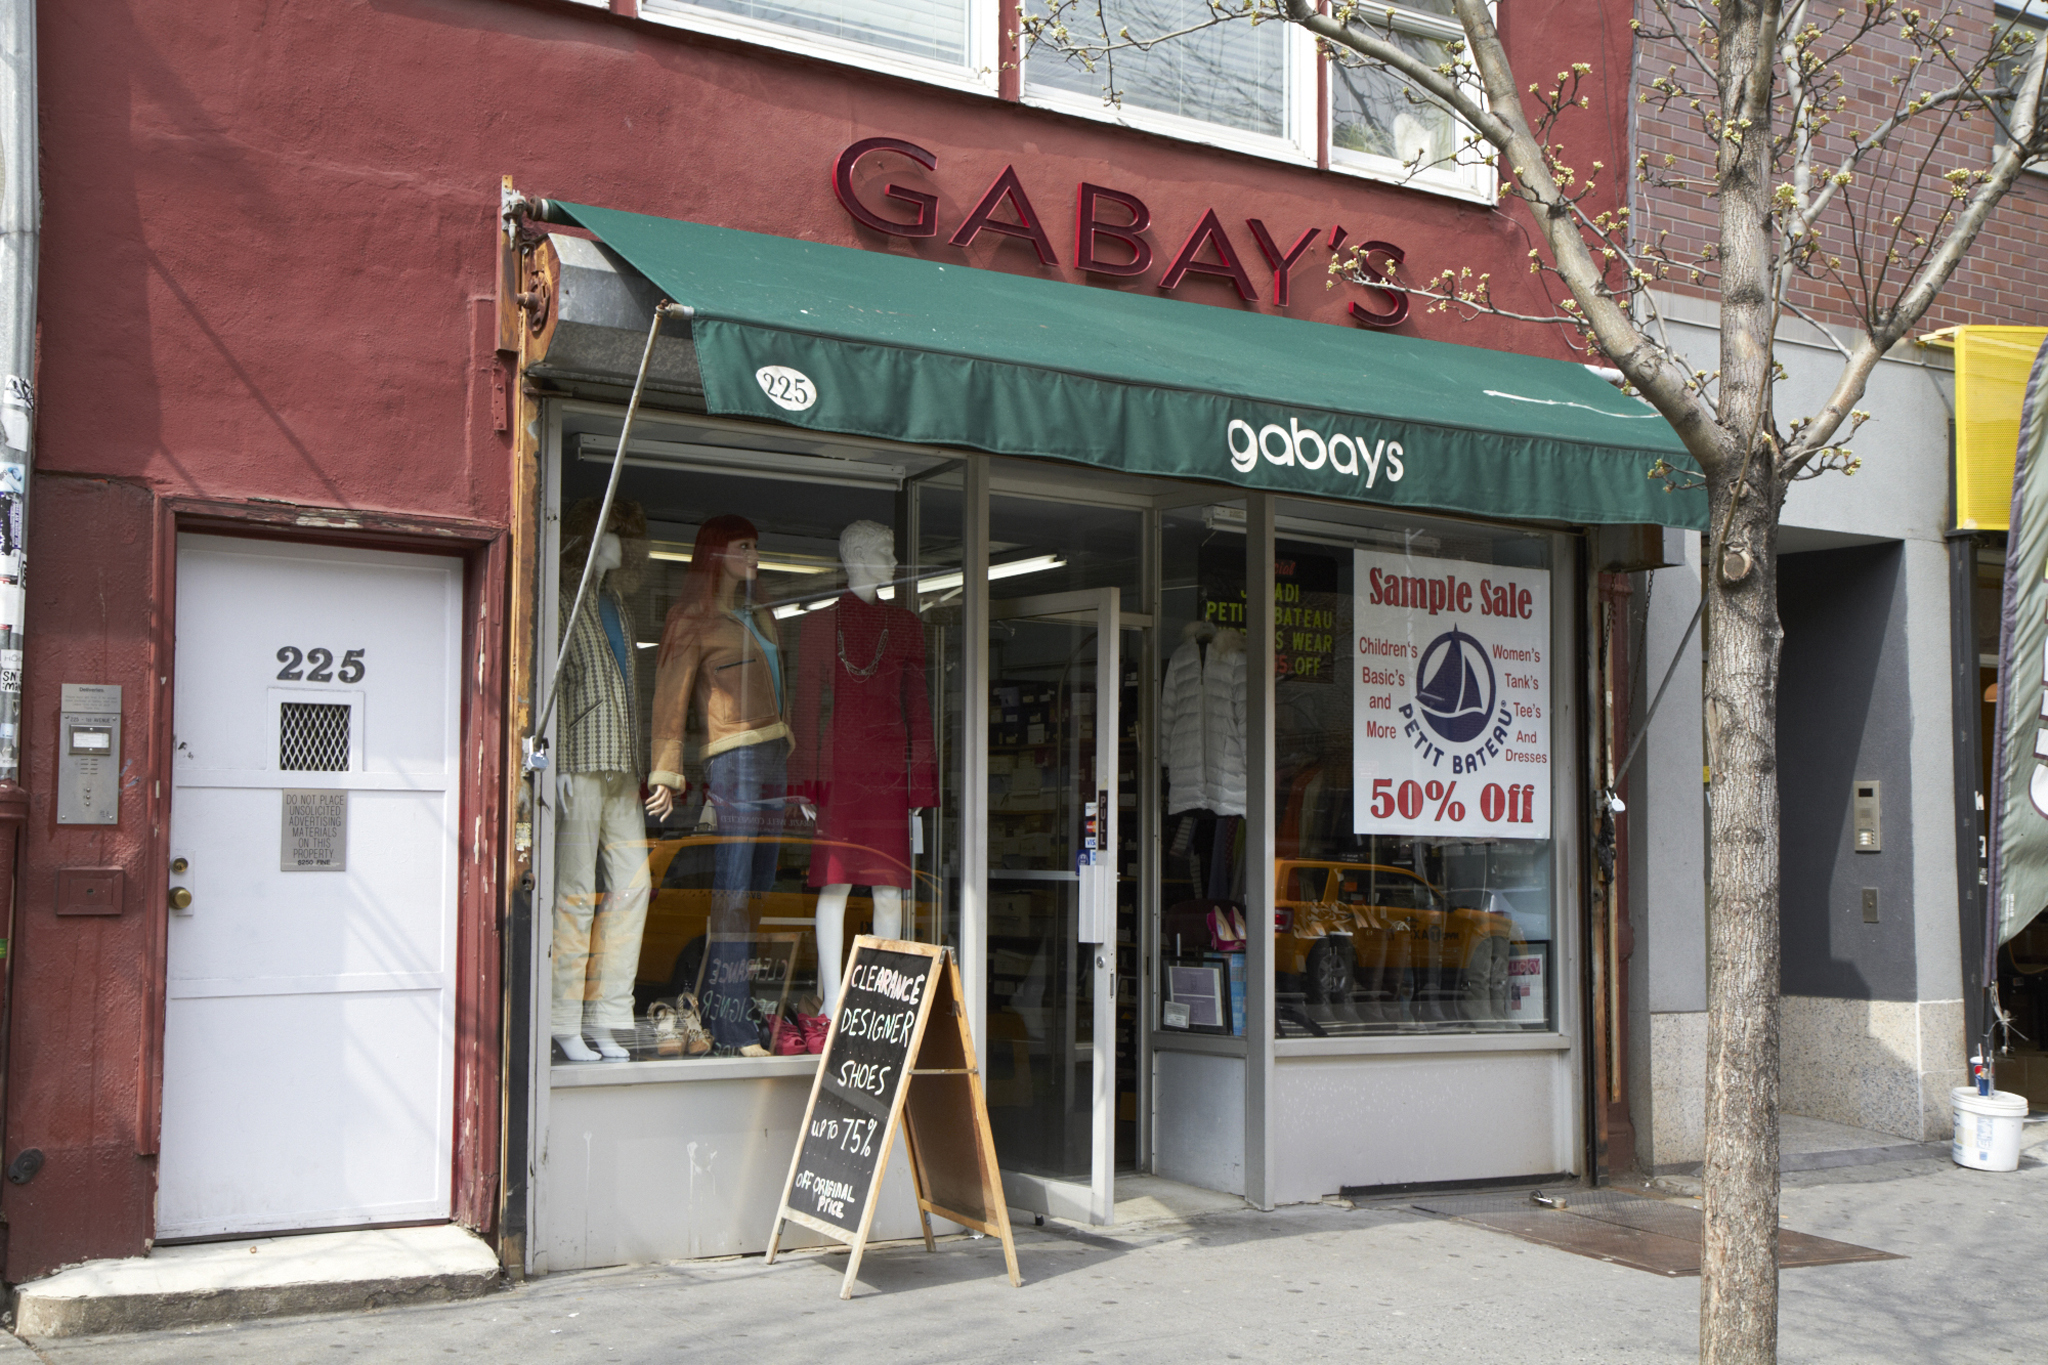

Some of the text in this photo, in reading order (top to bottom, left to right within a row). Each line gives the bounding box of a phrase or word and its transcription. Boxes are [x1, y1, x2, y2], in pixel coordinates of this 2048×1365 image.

[832, 137, 1409, 326] GABAY'S
[763, 372, 808, 404] 225
[1227, 418, 1404, 489] gabays
[1369, 567, 1533, 619] Sample Sale
[1293, 632, 1333, 653] WEAR
[1492, 643, 1541, 662] Women's
[276, 646, 365, 683] 225
[1295, 656, 1321, 676] OFF
[1362, 666, 1405, 687] Basic's
[1504, 672, 1539, 690] Tank's
[1369, 693, 1391, 710] and
[1513, 702, 1541, 718] Tee's
[1366, 720, 1397, 739] More
[1398, 703, 1445, 767] PETIT
[1516, 730, 1537, 743] And
[1505, 748, 1547, 764] Dresses
[286, 794, 344, 806] DO NOT PLACE
[1370, 778, 1535, 823] 50% Off
[289, 806, 341, 816] UNSOLICITED
[289, 816, 341, 827] ADVERTISING
[292, 827, 337, 838] MATERIALS
[298, 838, 331, 848] ON THIS
[851, 964, 926, 1005] CLEARANCE
[840, 1007, 915, 1048] DESIGNER
[837, 1060, 891, 1096] SHOES
[840, 1118, 878, 1157] 75%
[813, 1176, 855, 1203] ORIGINAL
